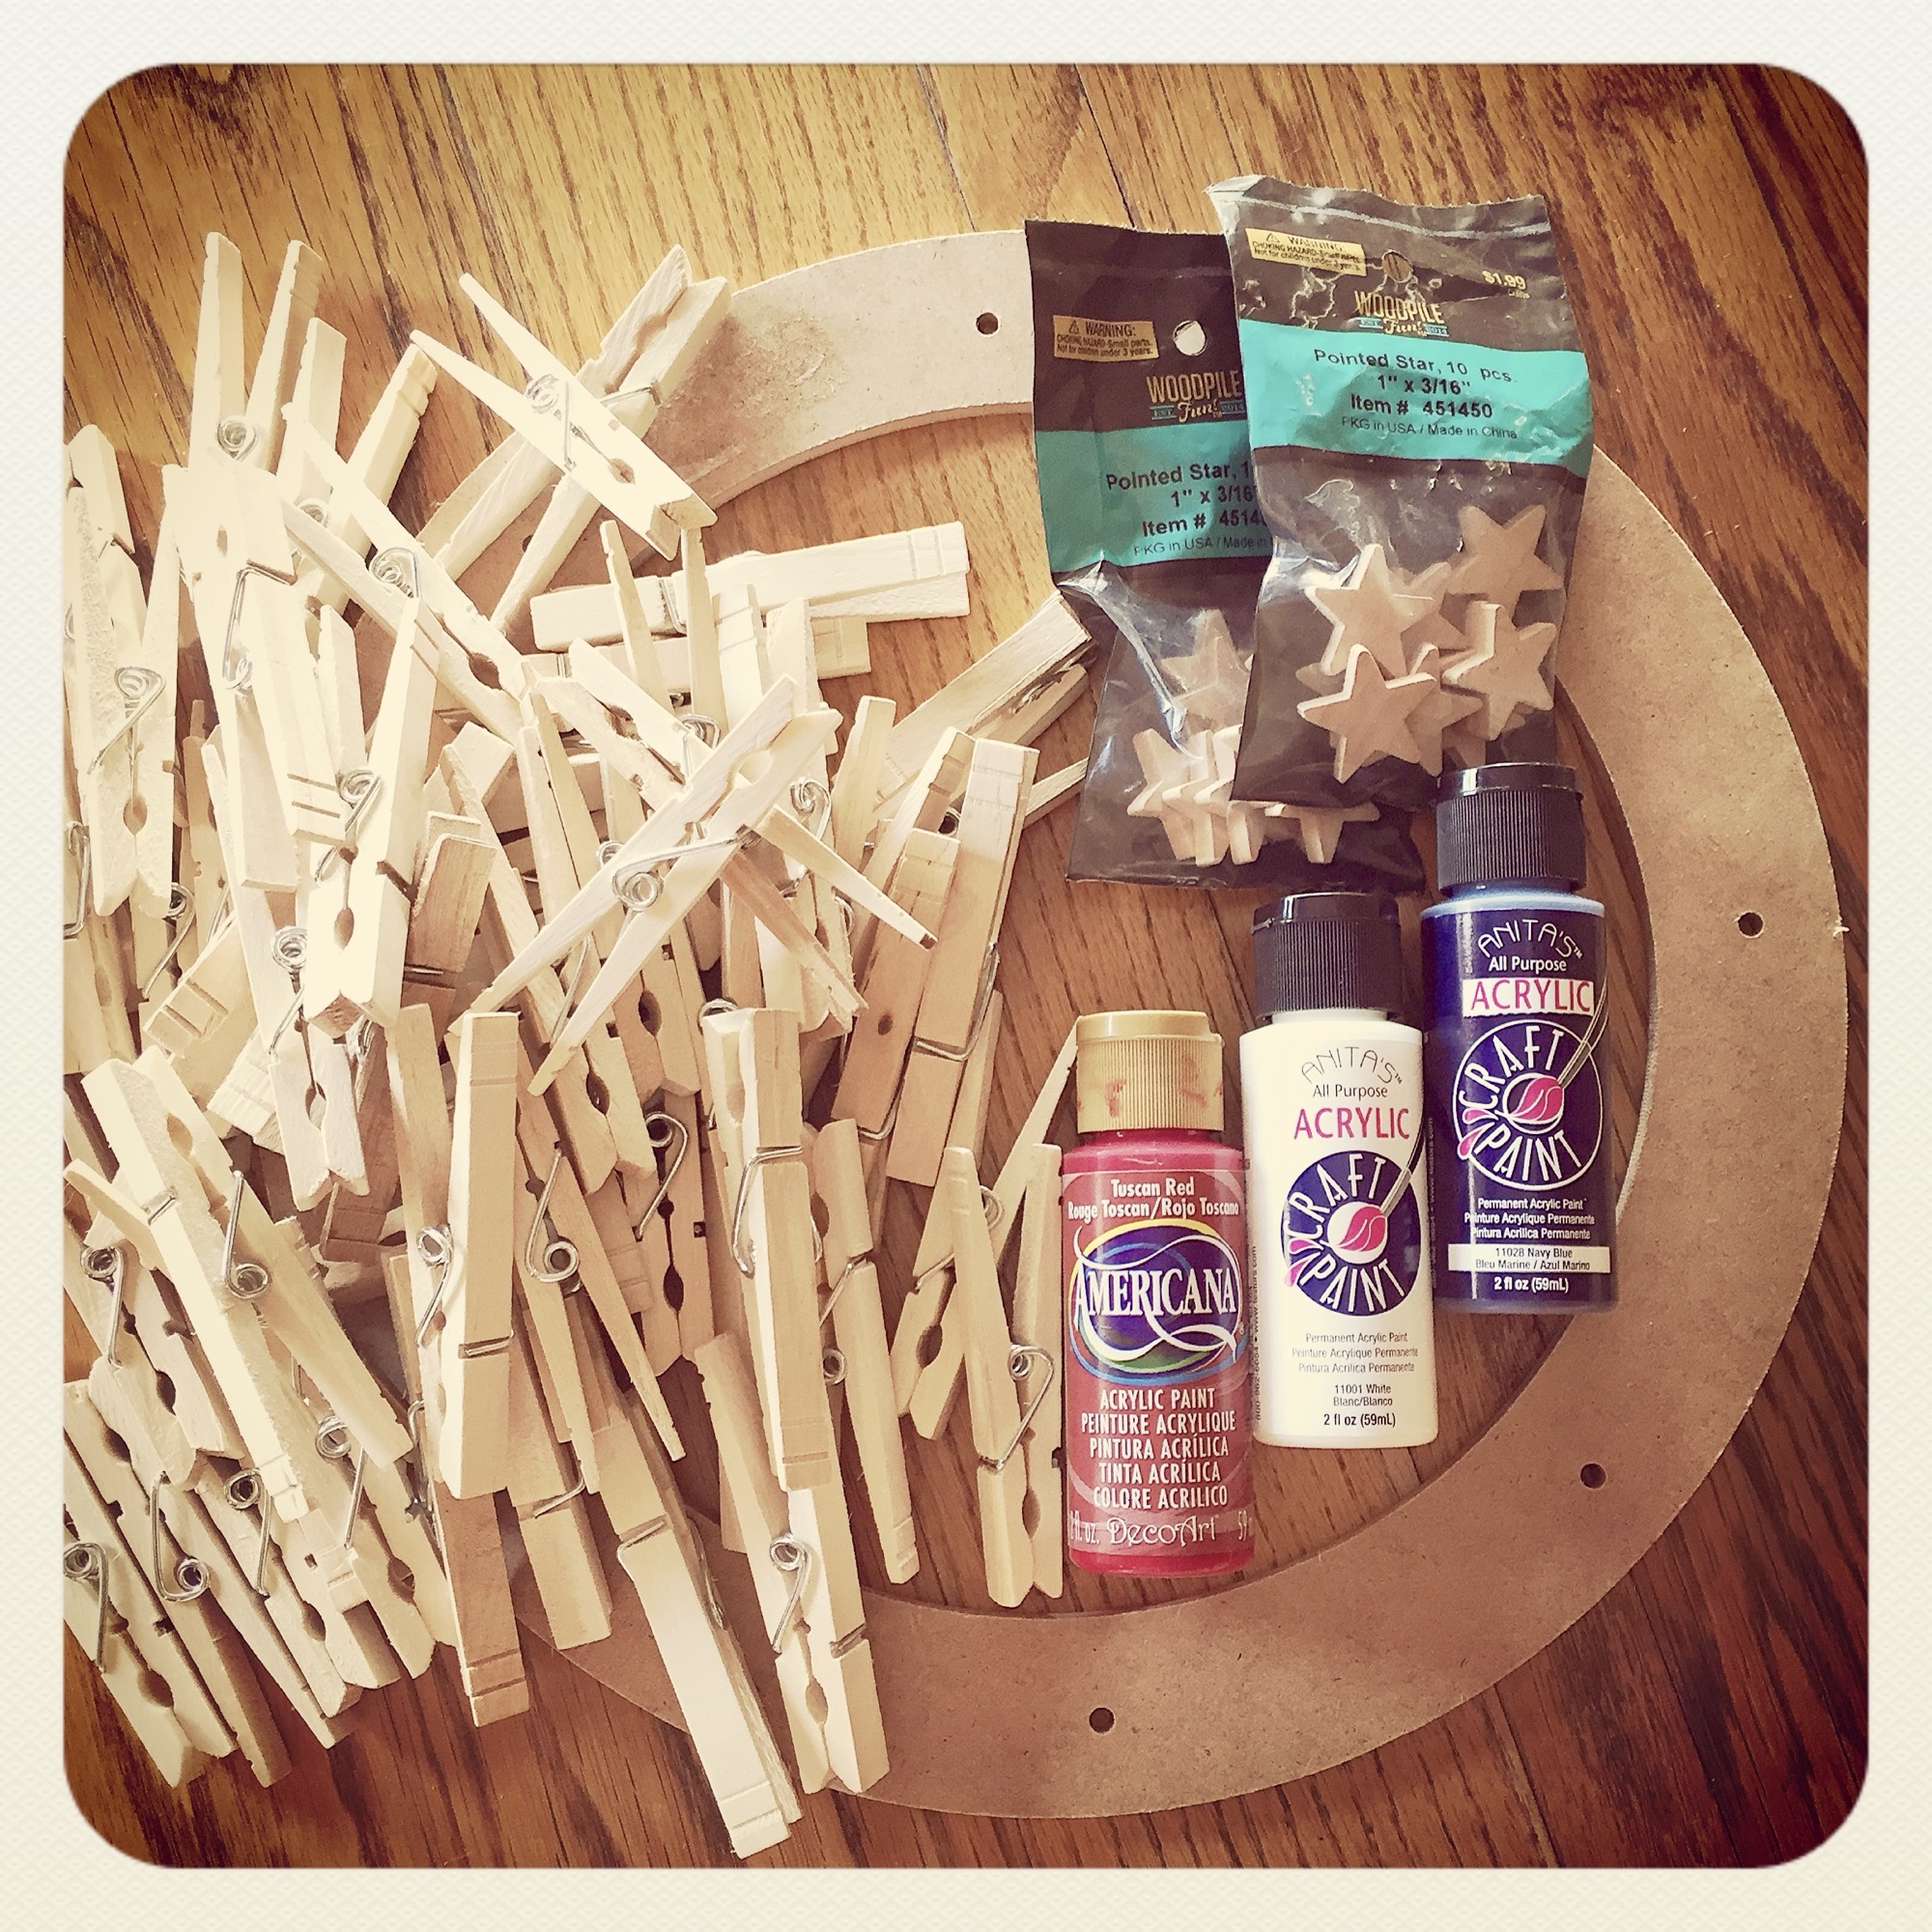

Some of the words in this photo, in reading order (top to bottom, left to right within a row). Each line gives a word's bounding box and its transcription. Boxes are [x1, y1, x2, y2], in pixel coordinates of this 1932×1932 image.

[1482, 270, 1526, 290] $1.99
[1354, 290, 1445, 325] WOODPILE
[1085, 321, 1136, 337] WARNING:
[1383, 318, 1422, 334] Fun!
[1122, 348, 1128, 356] 3
[1314, 349, 1389, 368] Pointed
[1396, 355, 1441, 375] Star,
[1447, 360, 1468, 375] 10
[1146, 370, 1242, 404] WOODPILE
[1378, 374, 1397, 390] 1"
[1404, 381, 1414, 393] x
[1421, 377, 1470, 396] 3/16"
[1178, 398, 1218, 423] Fun!
[1350, 393, 1391, 414] Item
[1397, 400, 1409, 415] #
[1422, 400, 1493, 418] 451450
[1342, 416, 1370, 431] PKG
[1374, 420, 1384, 431] in
[1387, 421, 1416, 435] USA
[1419, 423, 1424, 434] /
[1428, 423, 1463, 437] Made
[1466, 426, 1478, 437] in
[1482, 425, 1519, 439] China
[1105, 466, 1182, 491] Pointed
[1189, 463, 1236, 481] Star,
[1170, 489, 1192, 508] 1"
[1200, 490, 1211, 505] x
[1142, 518, 1188, 537] Item
[1192, 512, 1208, 529] #
[1219, 509, 1267, 527] 4514
[1134, 541, 1166, 556] PKG
[1169, 539, 1180, 552] in
[1184, 535, 1213, 551] USA
[1215, 536, 1221, 547] /
[1223, 535, 1253, 549] Made
[1488, 955, 1507, 973] All
[1511, 956, 1567, 975] Purpose
[1470, 979, 1590, 1012] ACRYLIC
[1459, 1025, 1565, 1110] CRAFT
[1312, 1084, 1329, 1097] All
[1335, 1084, 1389, 1101] Purpose
[1293, 1107, 1410, 1140] ACRYLIC
[1473, 1122, 1582, 1181] PAINT
[1111, 1179, 1161, 1198] Tuscan
[1165, 1177, 1195, 1196] Red
[1283, 1153, 1387, 1239] CRAFT
[1067, 1202, 1097, 1224] Rouge
[1200, 1197, 1239, 1215] Toscano
[1478, 1198, 1528, 1209] Permanent
[1530, 1198, 1561, 1211] Acrylic
[1563, 1198, 1584, 1209] Paint
[1464, 1211, 1499, 1223] Peinture
[1501, 1212, 1546, 1225] Acrylique
[1548, 1213, 1596, 1225] Permanente
[1470, 1228, 1502, 1238] Pintura
[1541, 1228, 1591, 1240] Permanente
[1495, 1248, 1524, 1258] 11028
[1527, 1248, 1551, 1260] Navy
[1553, 1248, 1573, 1259] Blue
[1476, 1260, 1495, 1269] Bleu
[1498, 1260, 1530, 1269] Marine
[1533, 1260, 1538, 1269] /
[1540, 1260, 1560, 1269] Azul
[1563, 1260, 1590, 1271] Marino
[1299, 1253, 1405, 1313] PAINT
[1493, 1277, 1503, 1291] 2
[1503, 1277, 1513, 1291] fl
[1515, 1280, 1528, 1291] oz
[1531, 1277, 1569, 1294] (59mL)
[1073, 1261, 1237, 1330] AMERICANA
[1306, 1332, 1354, 1343] Permanent
[1358, 1332, 1387, 1345] Acrylic
[1389, 1332, 1408, 1343] Paint
[1292, 1348, 1327, 1358] Peinture
[1329, 1348, 1373, 1360] Acrylique
[1375, 1348, 1418, 1358] Permanente
[1298, 1362, 1329, 1373] Pintura
[1368, 1362, 1415, 1373] Permanente
[1099, 1389, 1164, 1410] ACRYLIC
[1171, 1387, 1215, 1409] PAINT
[1335, 1383, 1362, 1394] 11001
[1366, 1383, 1392, 1394] White
[1333, 1397, 1393, 1406] Blanc/Blanco
[1081, 1412, 1150, 1435] PEINTURE
[1155, 1410, 1236, 1435] ACRYLIQUE
[1323, 1413, 1330, 1426] 2
[1334, 1413, 1341, 1426] fl
[1345, 1416, 1356, 1426] oz
[1360, 1412, 1396, 1428] (59mL)
[1090, 1437, 1154, 1460] PINTURA
[1099, 1462, 1142, 1485] TINTA
[1093, 1486, 1151, 1509] COLORE
[1157, 1486, 1229, 1509] ACRILICO
[1107, 1515, 1216, 1548] DecoArt
